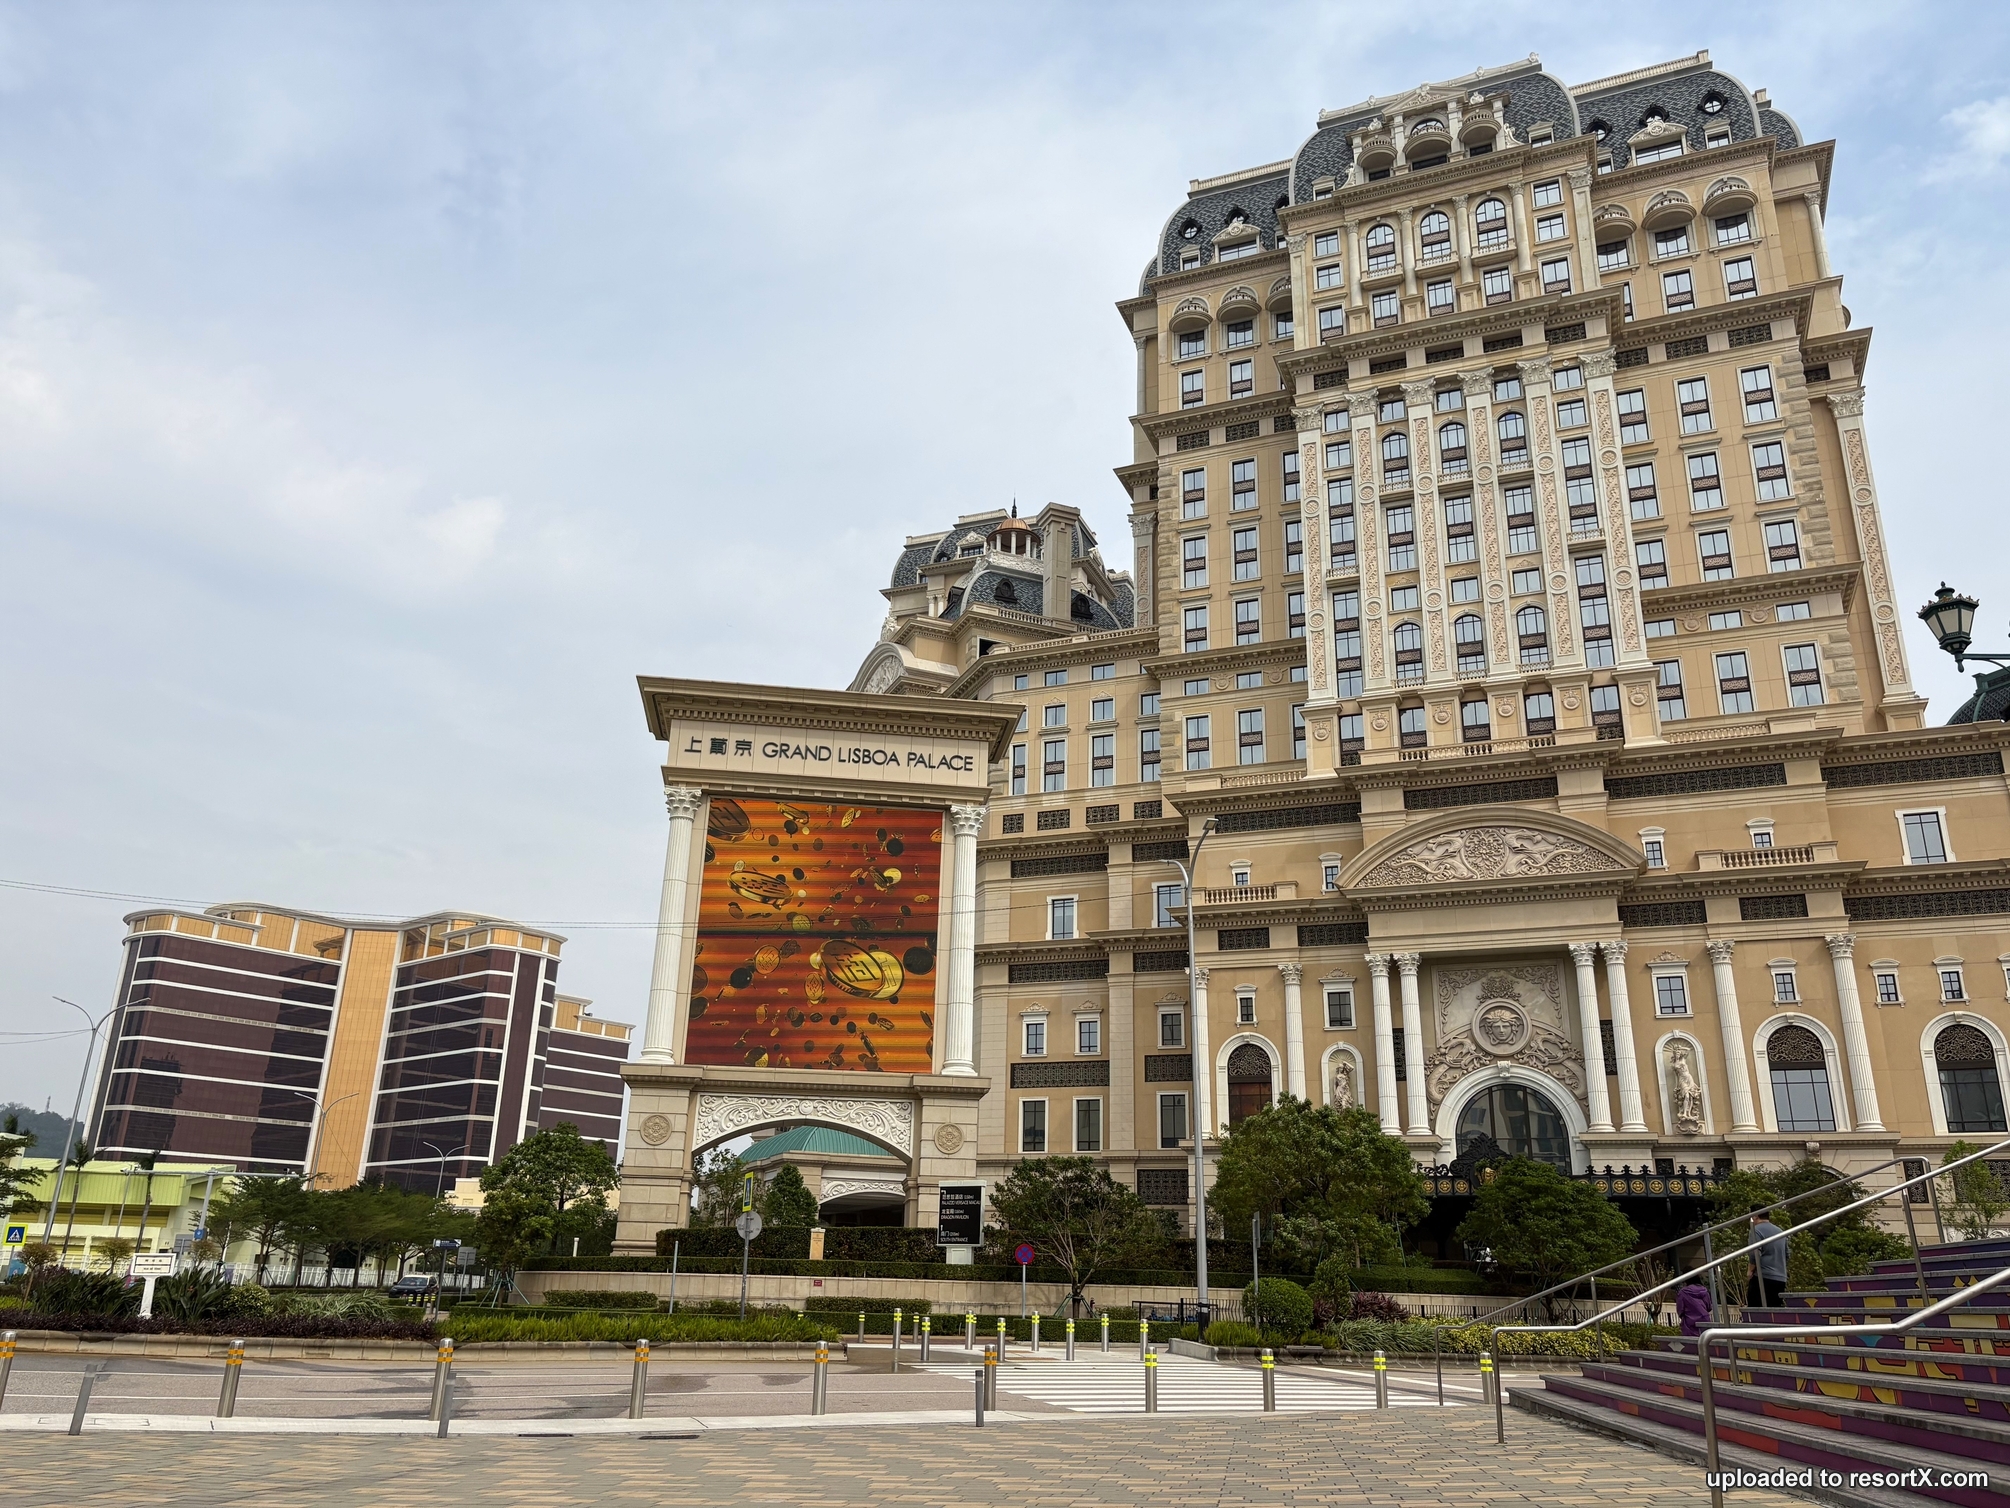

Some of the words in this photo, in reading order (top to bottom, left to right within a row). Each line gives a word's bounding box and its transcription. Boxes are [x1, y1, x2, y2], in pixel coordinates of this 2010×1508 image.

[684, 736, 753, 757] 上葡京
[762, 742, 832, 762] GRAND
[838, 747, 900, 767] LISBOA
[907, 752, 974, 772] PALACE
